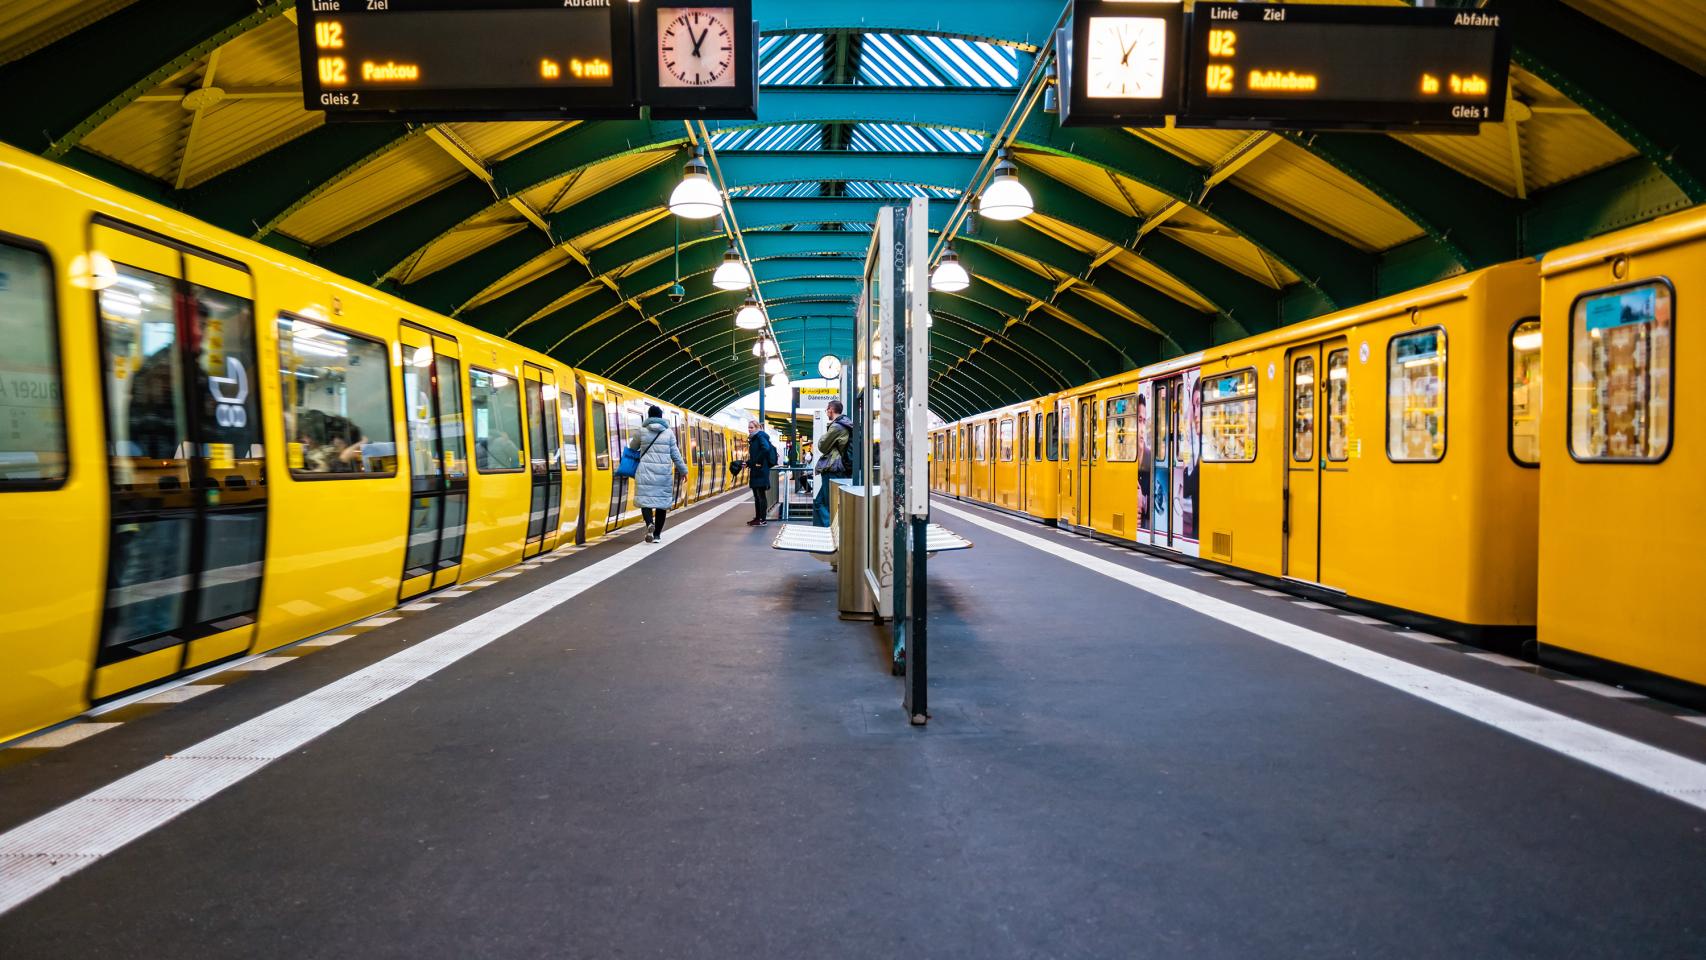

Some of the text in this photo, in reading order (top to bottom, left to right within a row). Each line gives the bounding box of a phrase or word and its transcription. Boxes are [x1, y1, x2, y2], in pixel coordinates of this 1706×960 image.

[312, 0, 340, 11] Linie
[366, 0, 389, 10] Ziel
[1210, 7, 1499, 27] Linie Ziel Abfahrt
[315, 21, 344, 49] U2
[1208, 29, 1236, 57] U2
[318, 56, 611, 84] U2 Pankow in 4 min
[1206, 64, 1234, 92] U2
[1248, 69, 1318, 91] Ruhleben
[1421, 73, 1440, 94] in
[320, 93, 360, 105] Gleis 2
[1451, 106, 1489, 118] Gleis 1
